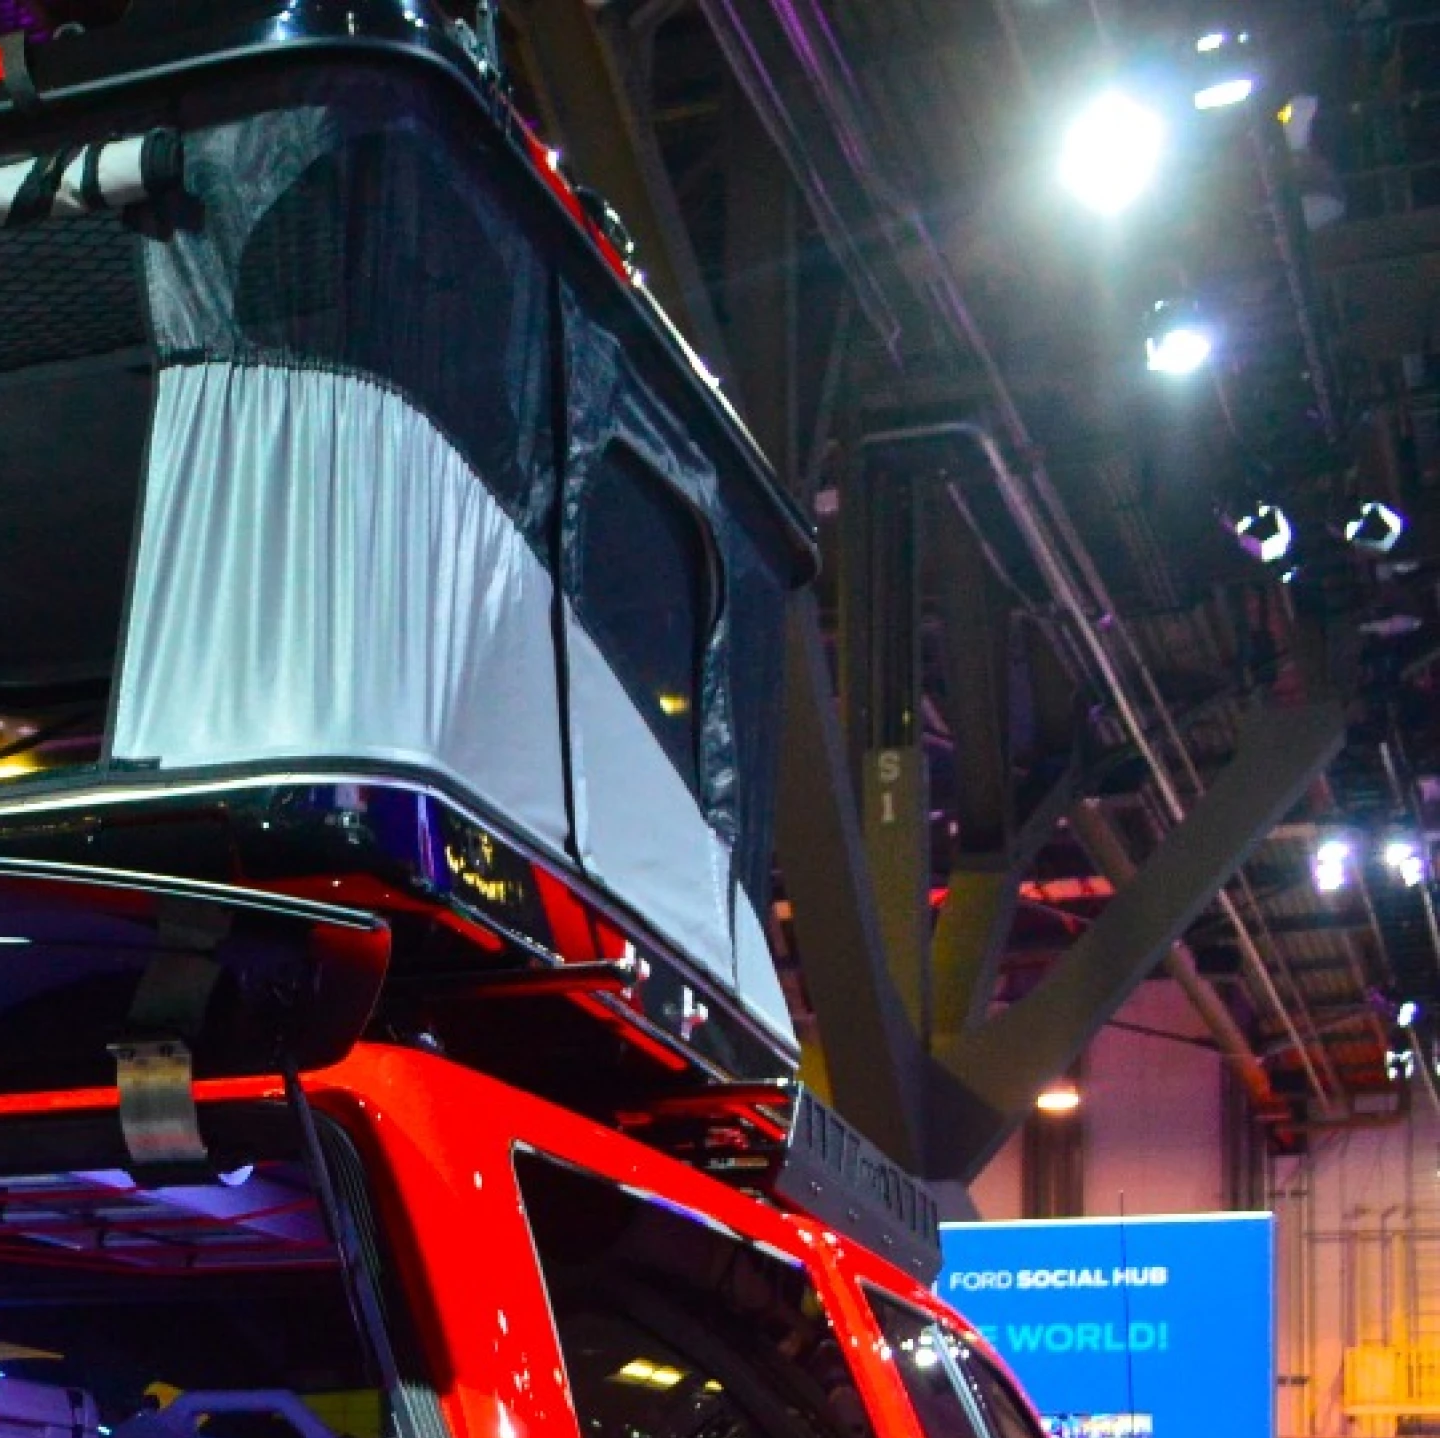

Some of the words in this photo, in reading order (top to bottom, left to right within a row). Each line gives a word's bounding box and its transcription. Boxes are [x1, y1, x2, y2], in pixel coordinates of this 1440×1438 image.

[950, 1270, 1012, 1290] FORD
[1016, 1267, 1109, 1289] SOCIAL
[1112, 1266, 1169, 1286] HUB
[1007, 1321, 1169, 1351] WORLD!
